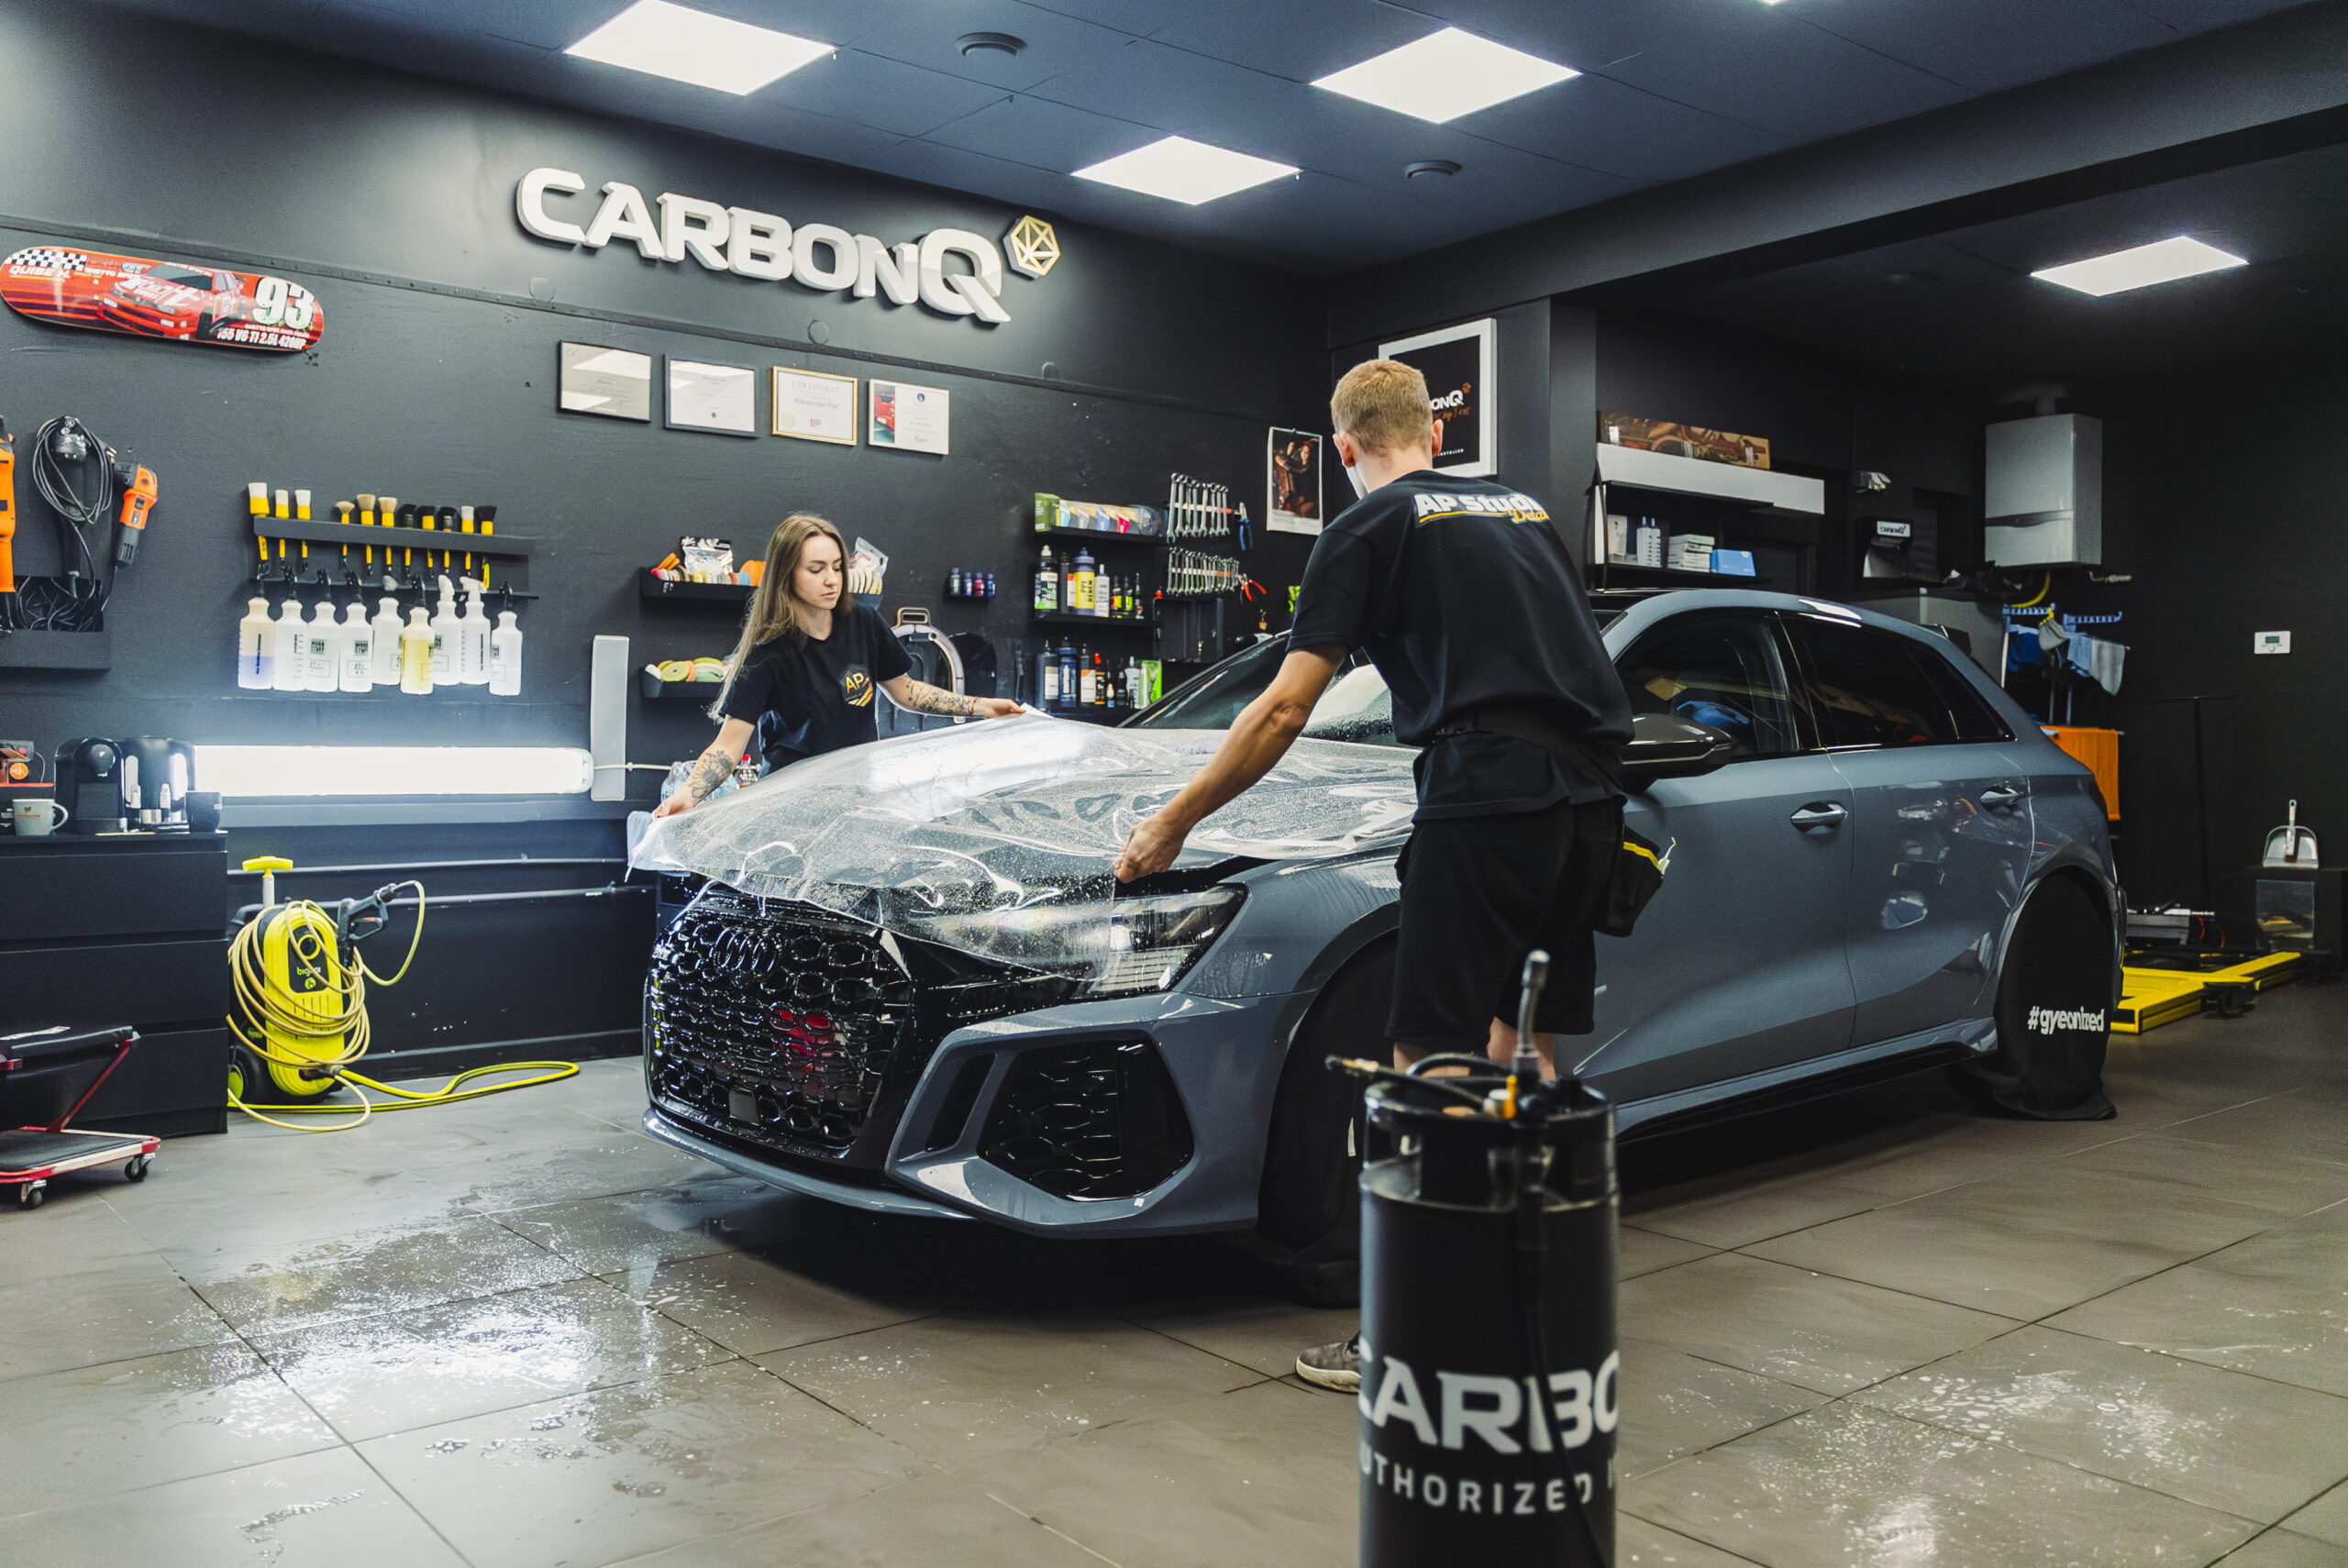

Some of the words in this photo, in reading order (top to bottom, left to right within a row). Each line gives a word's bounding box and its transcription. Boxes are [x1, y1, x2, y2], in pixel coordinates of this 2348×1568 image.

[515, 167, 1012, 323] CARBONQ
[252, 276, 316, 330] 93
[1414, 493, 1457, 517] AP
[846, 672, 864, 694] AP
